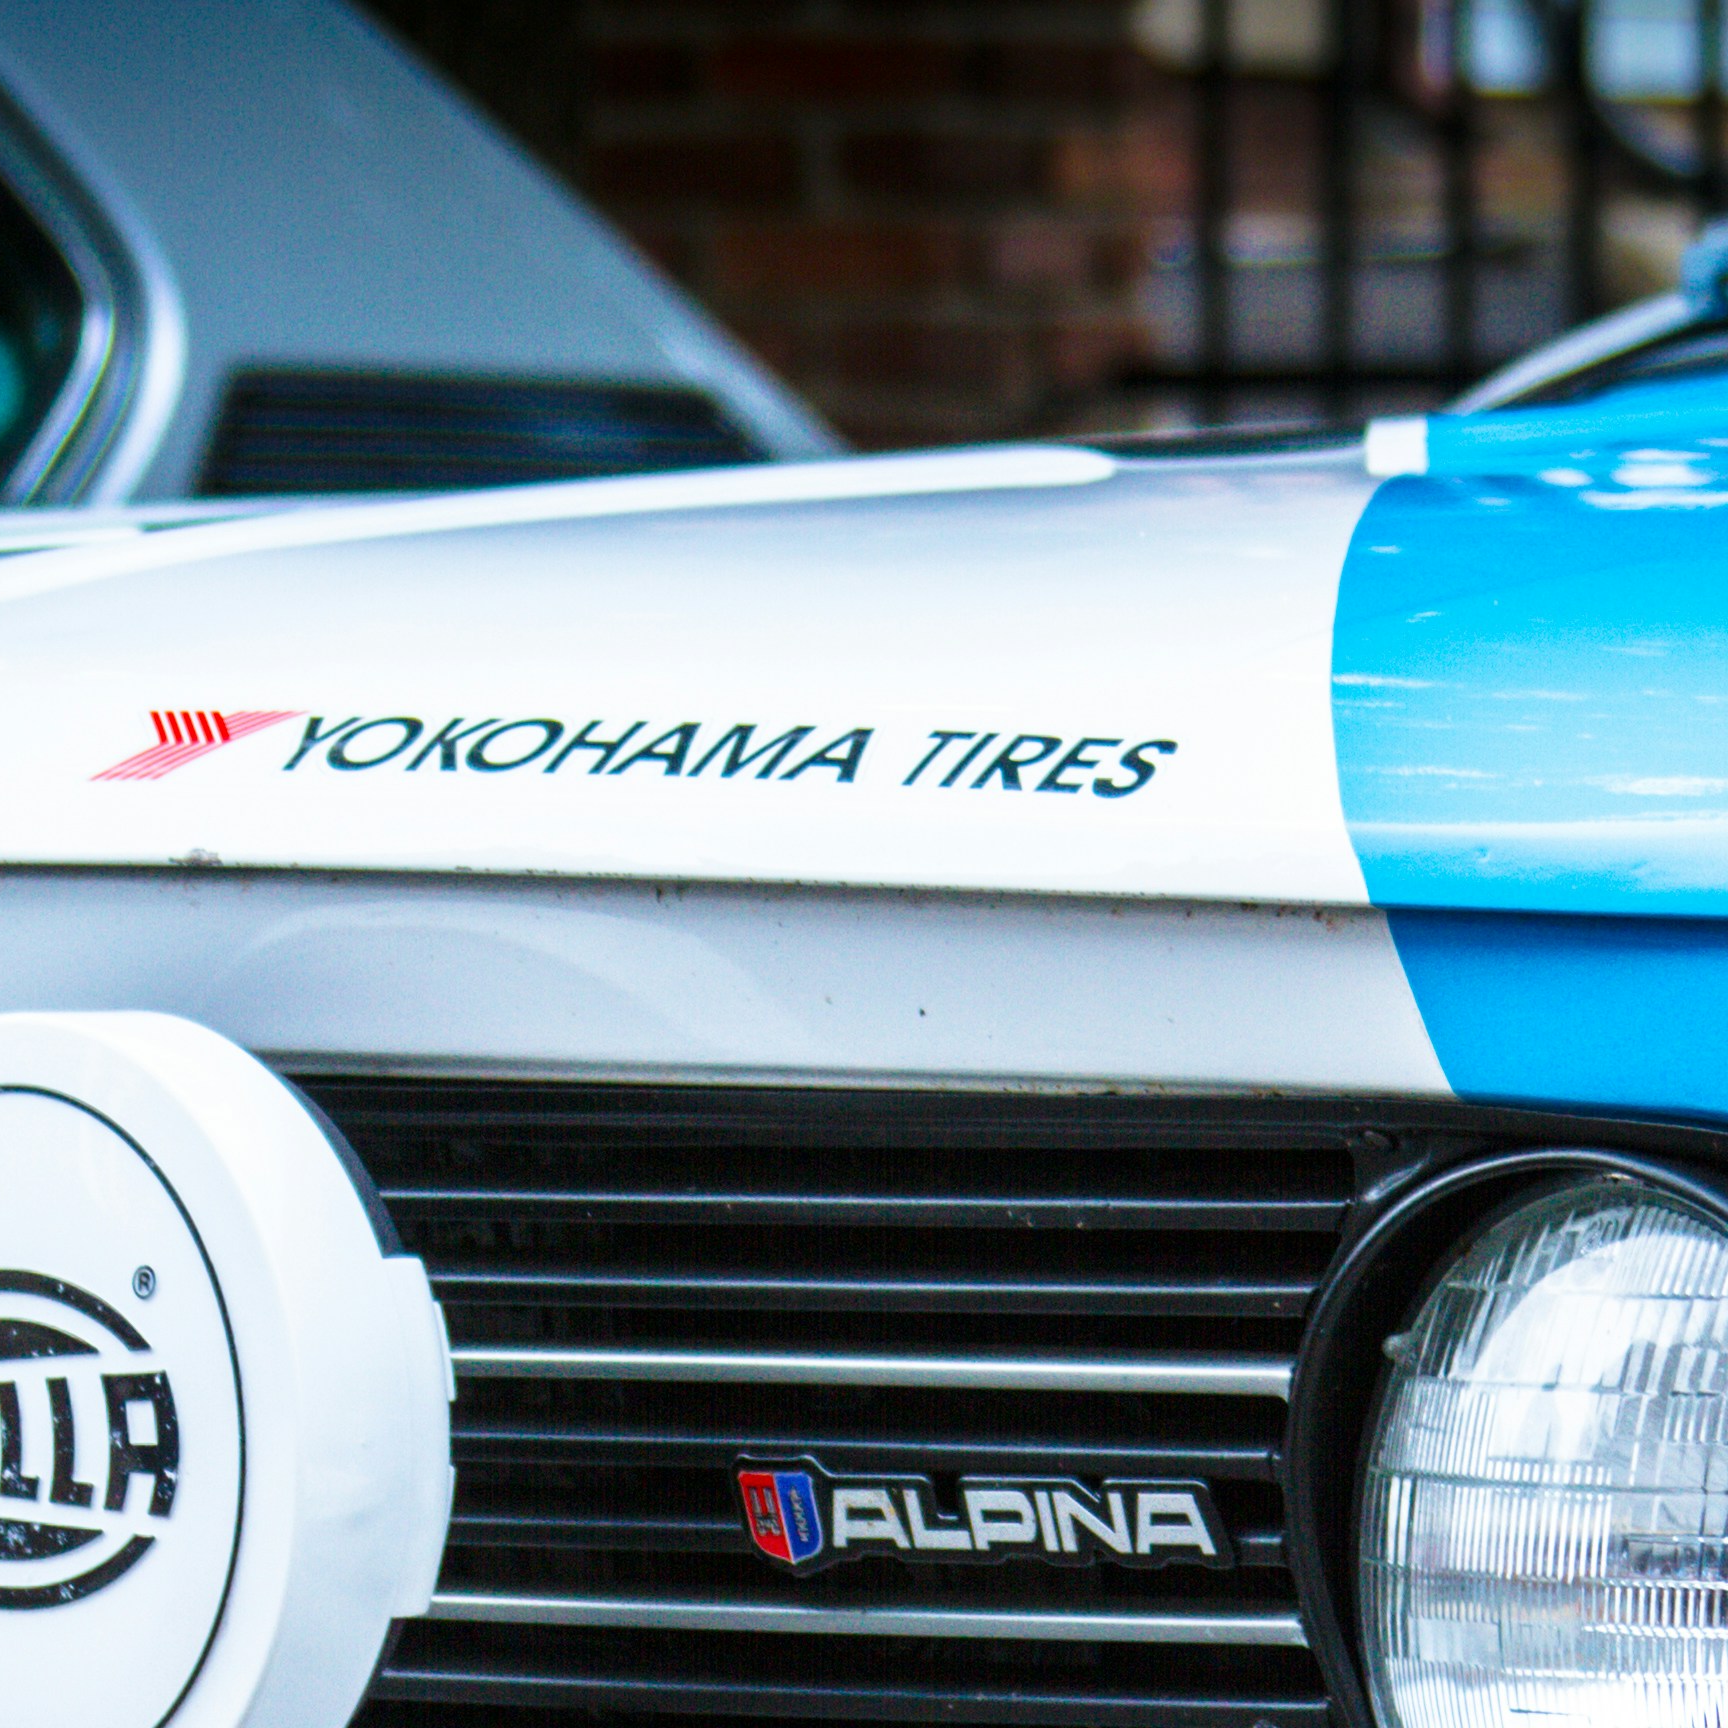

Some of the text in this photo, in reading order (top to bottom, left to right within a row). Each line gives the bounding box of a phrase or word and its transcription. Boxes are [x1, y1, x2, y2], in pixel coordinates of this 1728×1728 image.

[283, 715, 1179, 799] YOKOHAMA TIRES
[832, 1488, 1218, 1556] ALPINA
